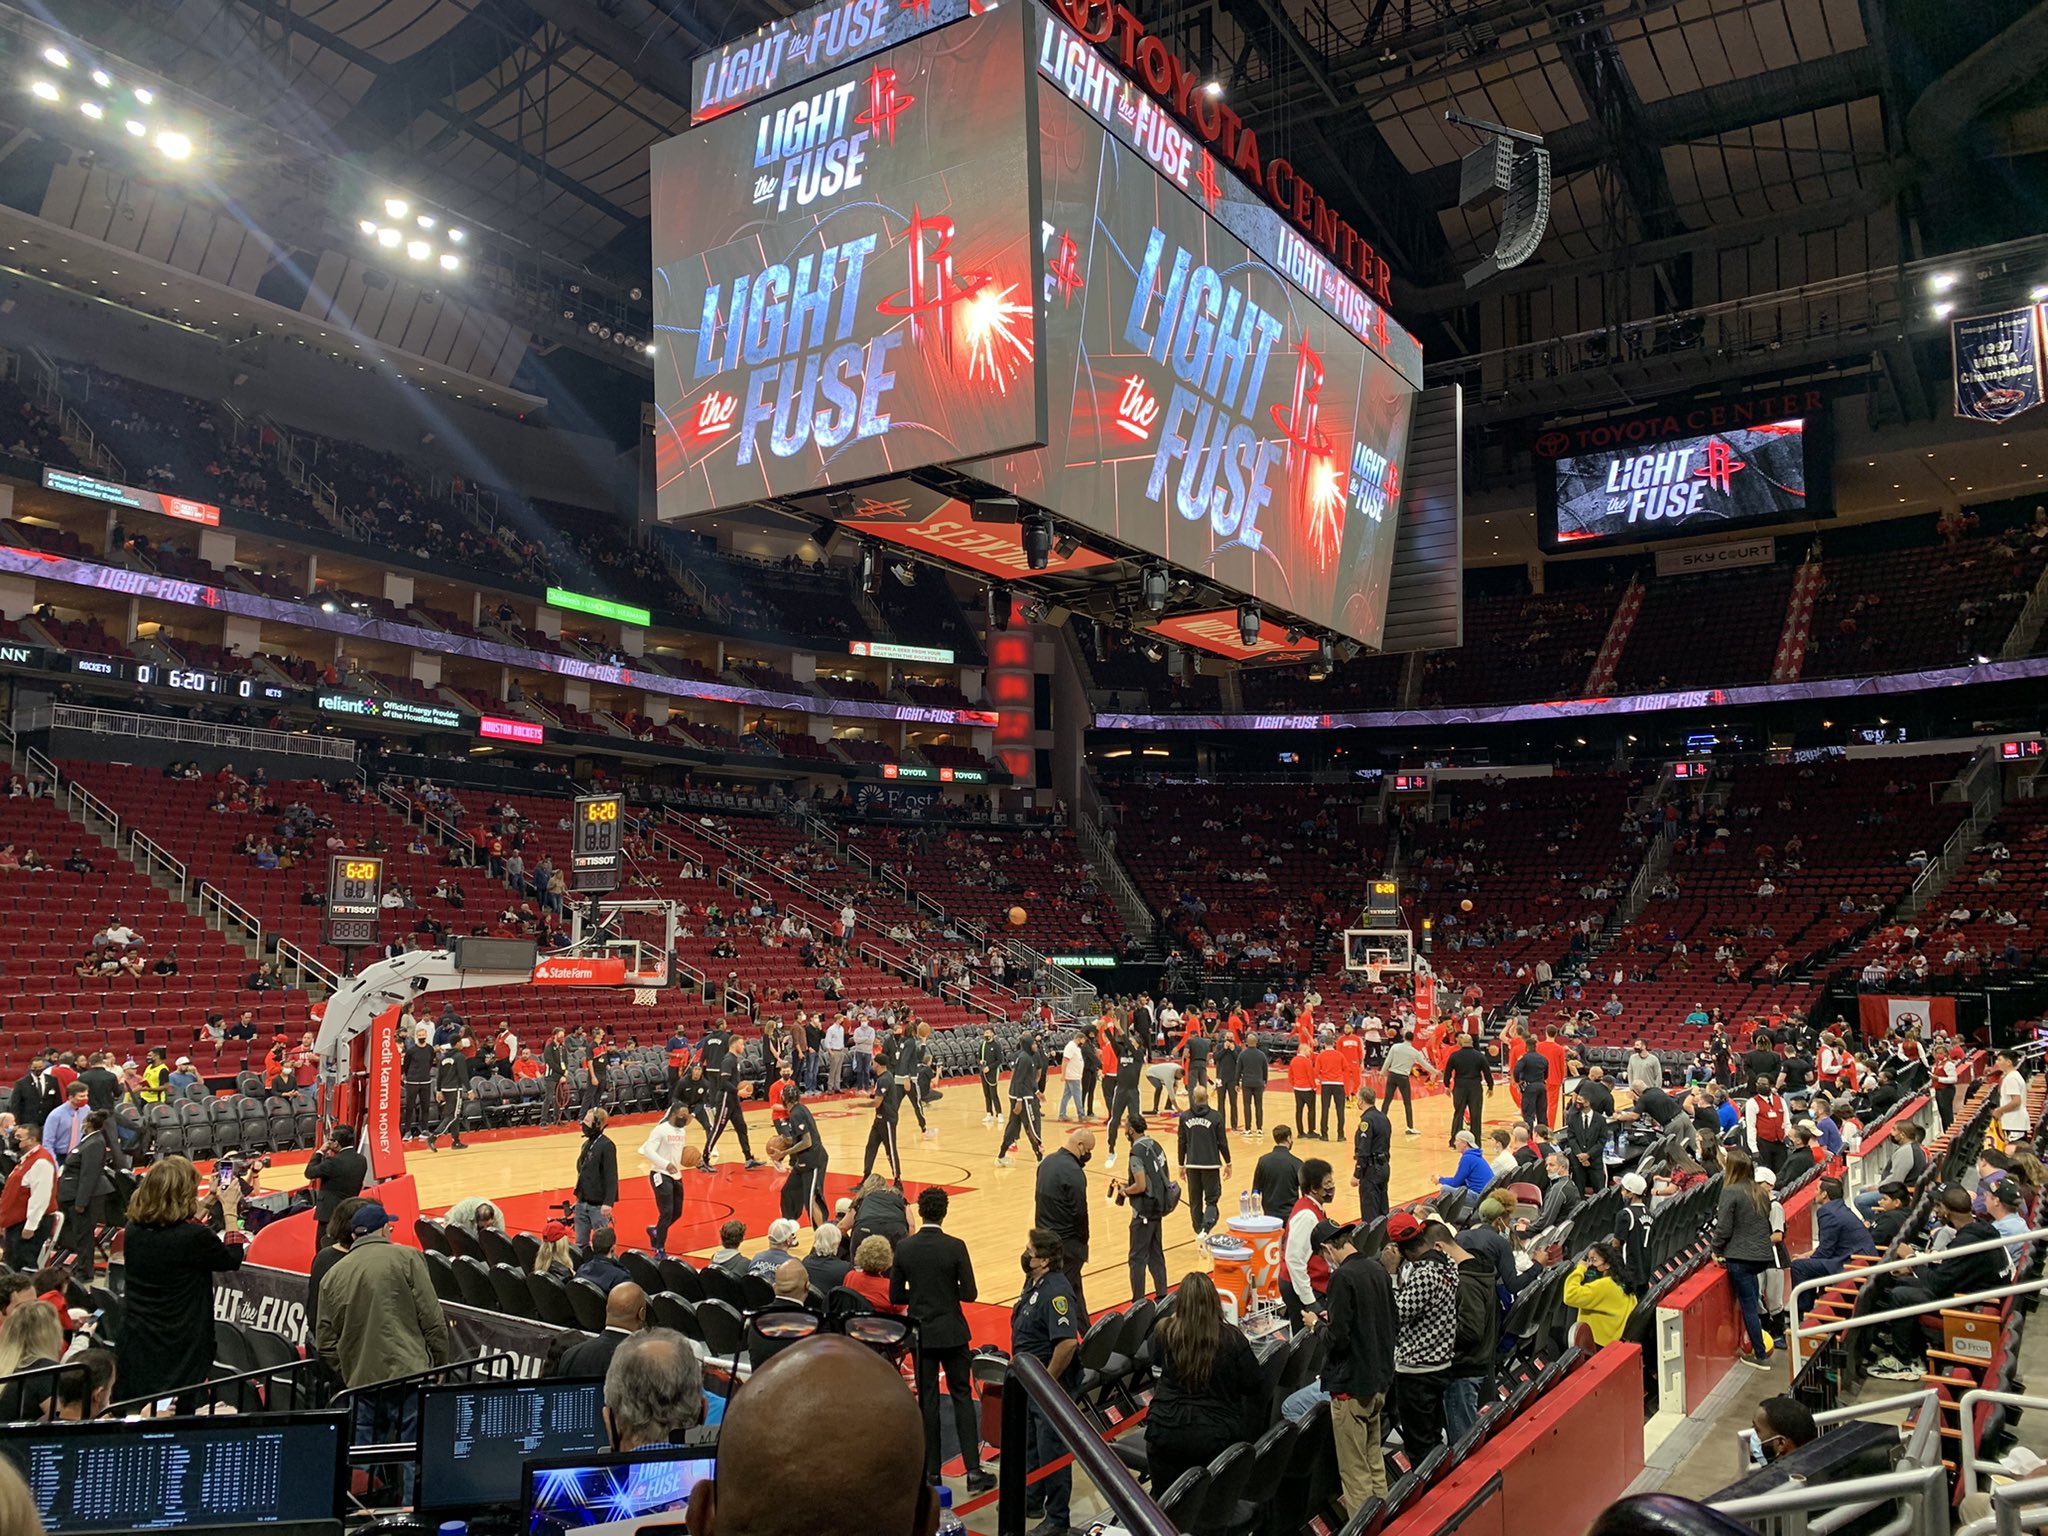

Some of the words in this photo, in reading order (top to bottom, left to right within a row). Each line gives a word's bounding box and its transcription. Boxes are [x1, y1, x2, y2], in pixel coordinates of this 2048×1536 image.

[701, 30, 790, 108] LIGHT
[788, 34, 810, 59] the
[807, 0, 890, 65] FUSE
[1039, 17, 1120, 122] LIGHT
[1117, 91, 1138, 126] the
[1132, 95, 1193, 187] FUSE
[753, 81, 856, 169] LIGHT
[1113, 6, 1263, 187] TOYOTA
[1267, 157, 1393, 305] CENTER
[753, 175, 778, 205] the
[777, 130, 870, 213] FUSE
[1275, 224, 1326, 301] LIGHT
[1333, 279, 1373, 340] FUSE
[693, 233, 877, 379] LIGHT
[1123, 225, 1284, 421] LIGHT
[1978, 340, 2012, 355] 1997
[1973, 352, 2019, 369] WNBA
[1960, 364, 2034, 384] Champions
[698, 391, 738, 435] the
[736, 331, 904, 467] FUSE
[1576, 415, 1680, 448] TOYOTA
[1686, 390, 1824, 430] CENTER
[1115, 373, 1160, 439] the
[1145, 382, 1283, 552] FUSE
[1352, 441, 1387, 482] LIGHT
[1605, 449, 1695, 494] LIGHT
[1355, 482, 1387, 523] FUSE
[1606, 496, 1629, 515] the
[1627, 479, 1709, 524] FUSE
[97, 568, 149, 595] LIGHT
[157, 580, 200, 604] FUSE
[79, 661, 111, 673] ROCKETS
[138, 665, 149, 683] 0
[558, 658, 590, 678] LIGHT
[594, 665, 620, 682] FUSE
[169, 670, 204, 691] 6:20
[240, 681, 250, 697] 0
[265, 688, 282, 698] NETS
[1635, 695, 1670, 711] LIGHT
[1677, 692, 1709, 708] FUSE
[318, 696, 364, 715] reliant
[383, 701, 408, 712] Official
[409, 704, 431, 717] Energy
[433, 708, 459, 719] Provider
[895, 707, 925, 720] LIGHT
[930, 709, 956, 724] FUSE
[382, 710, 389, 718] of
[388, 711, 403, 719] the
[404, 713, 432, 723] Houston
[433, 716, 459, 727] Rockets
[1254, 716, 1286, 729] LIGHT
[1292, 715, 1319, 729] FUSE
[481, 720, 512, 734] HOUSTON
[513, 724, 543, 739] ROCKETS
[899, 768, 927, 777] TOYOTA
[954, 771, 982, 780] TOYOTA
[589, 802, 616, 820] 6:20
[347, 862, 374, 879] 6:20
[586, 856, 615, 865] TISSOT
[1375, 883, 1395, 894] 6:20
[345, 906, 377, 914] TISSOT
[1053, 957, 1085, 966] TUNDRA
[1085, 957, 1116, 966] TUNNEL
[382, 1027, 393, 1066] credit
[379, 1067, 392, 1110] karma
[378, 1112, 391, 1154] MONEY
[1643, 1225, 1650, 1248] 7
[240, 1301, 257, 1325] the
[1968, 1343, 1989, 1352] Frost
[646, 1469, 680, 1500] FUSE
